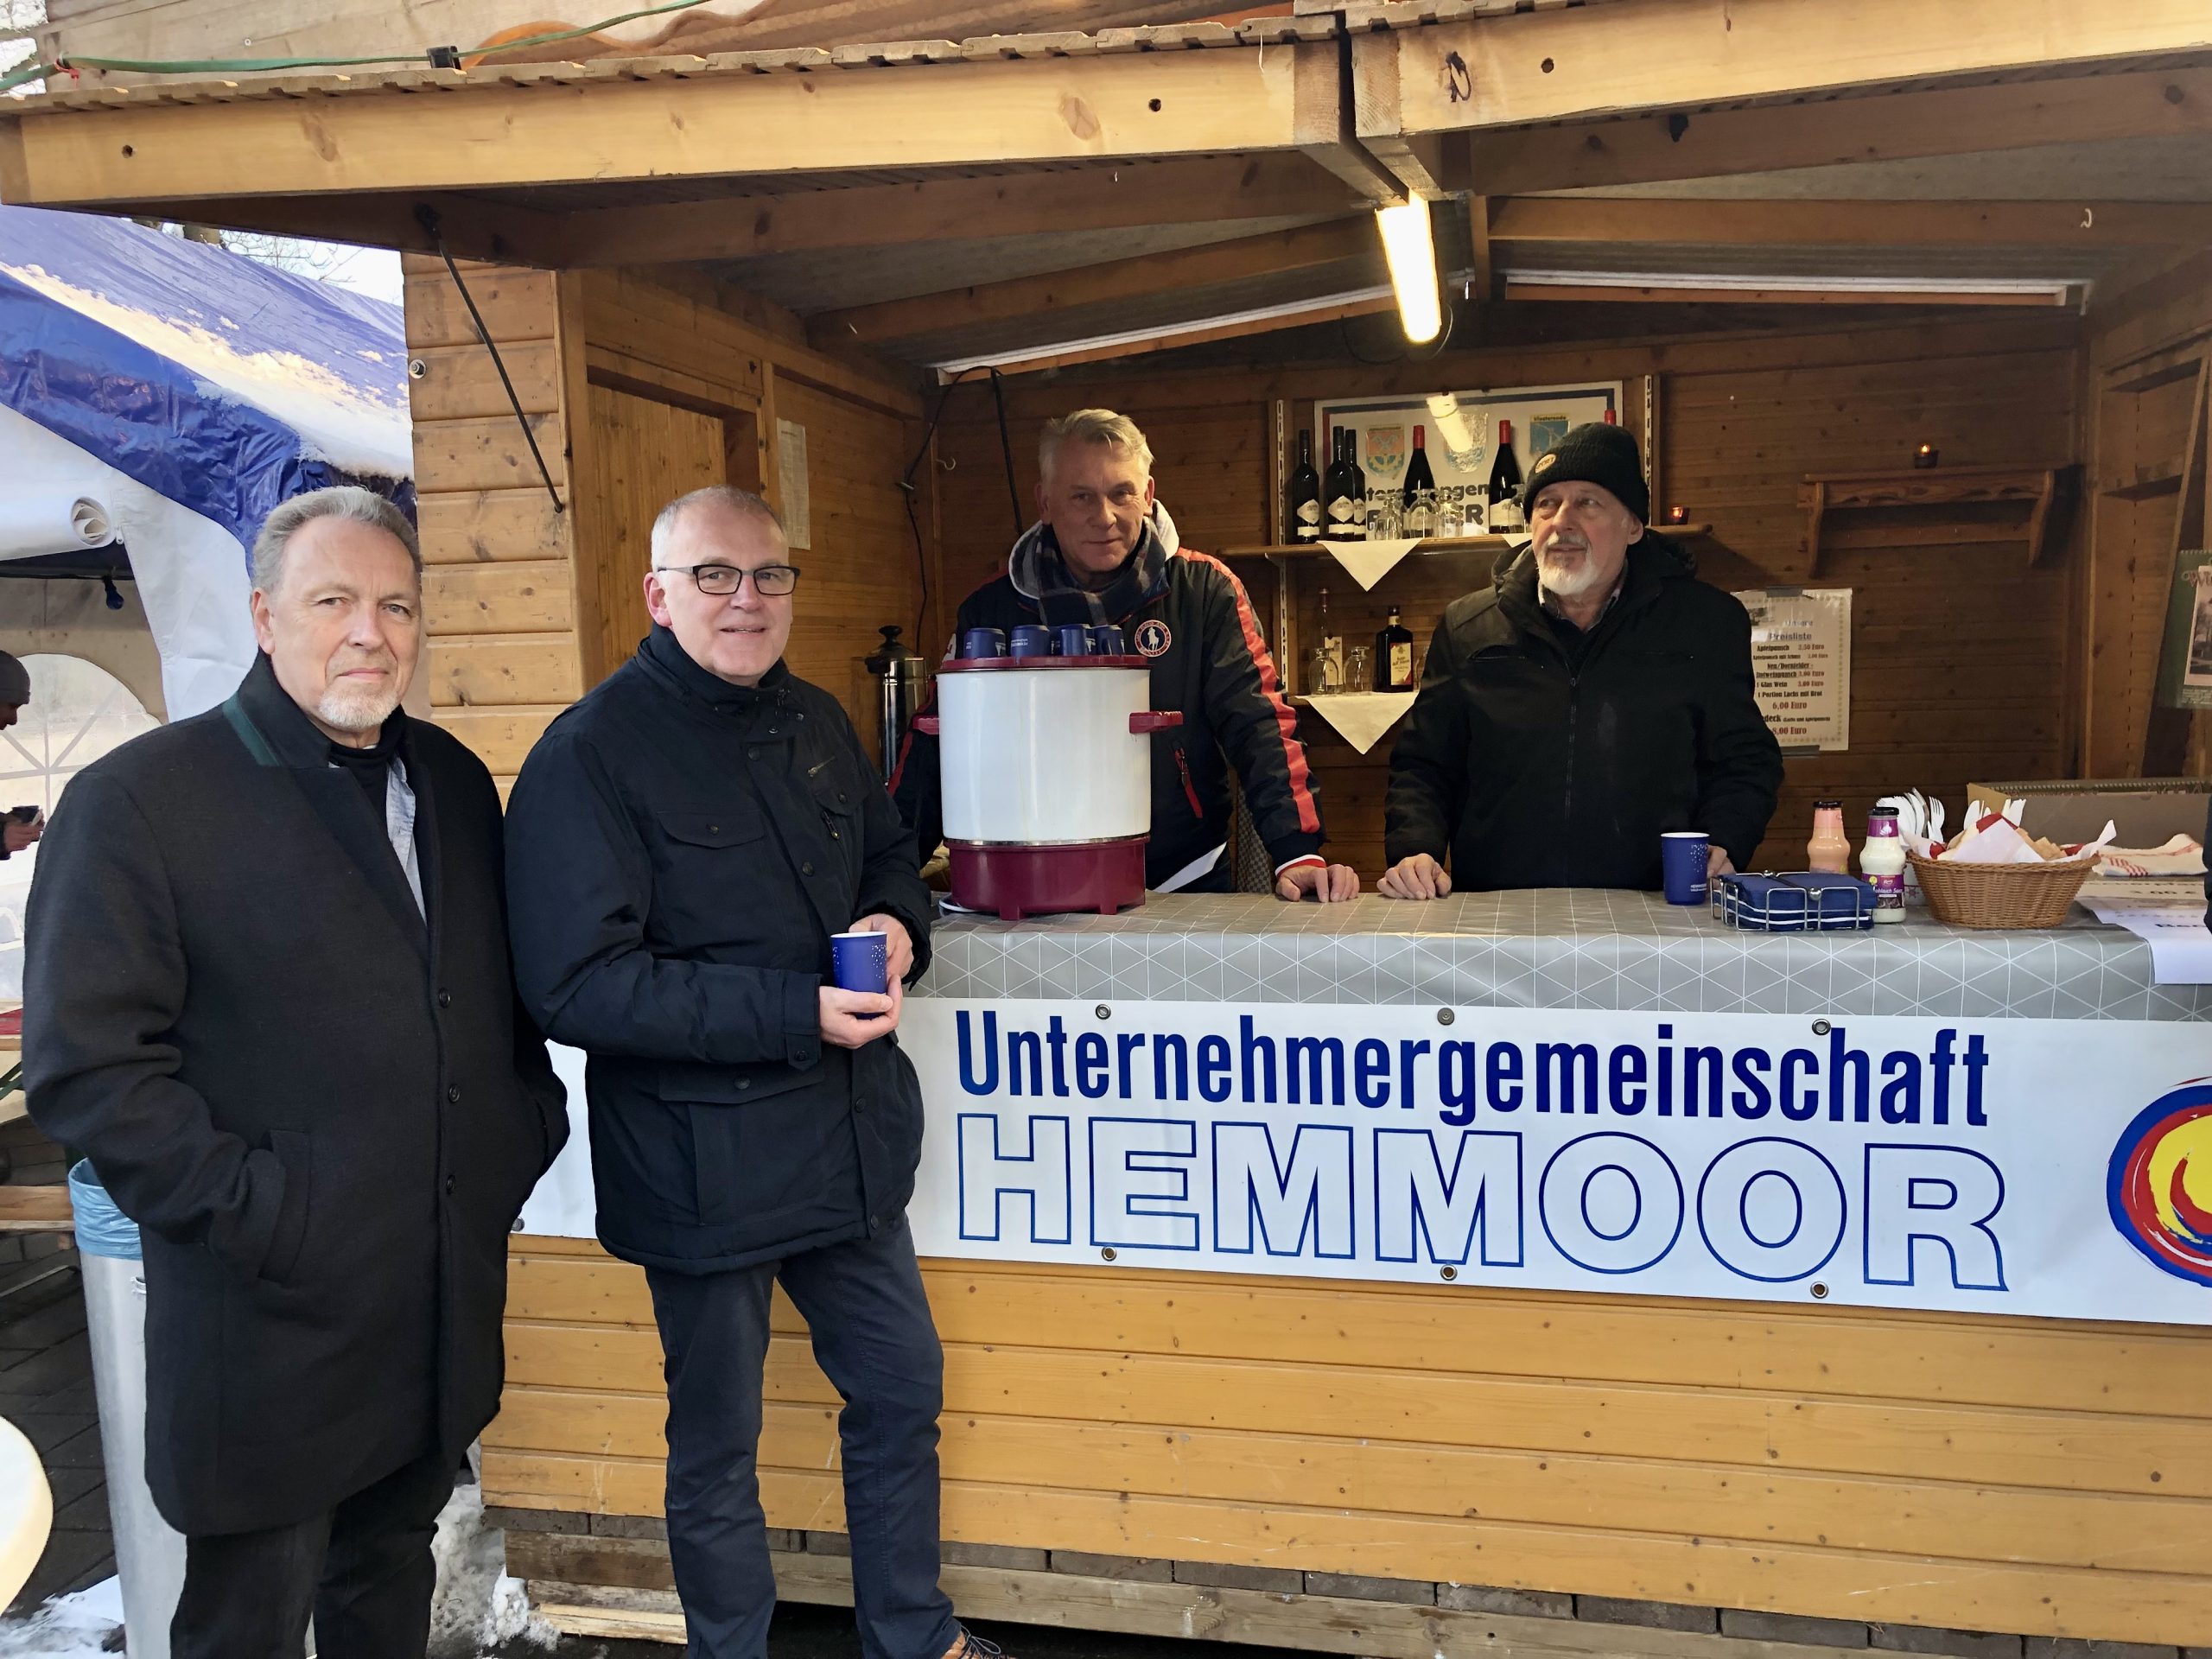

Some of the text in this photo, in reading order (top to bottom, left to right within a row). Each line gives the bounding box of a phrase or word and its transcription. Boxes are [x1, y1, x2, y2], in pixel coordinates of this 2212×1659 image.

[1770, 632, 1812, 641] Preisliste
[1790, 726, 1807, 734] Euro
[957, 1010, 1988, 1127] Unternehmergemeinschaft
[957, 1113, 2009, 1292] HEMMOOR
